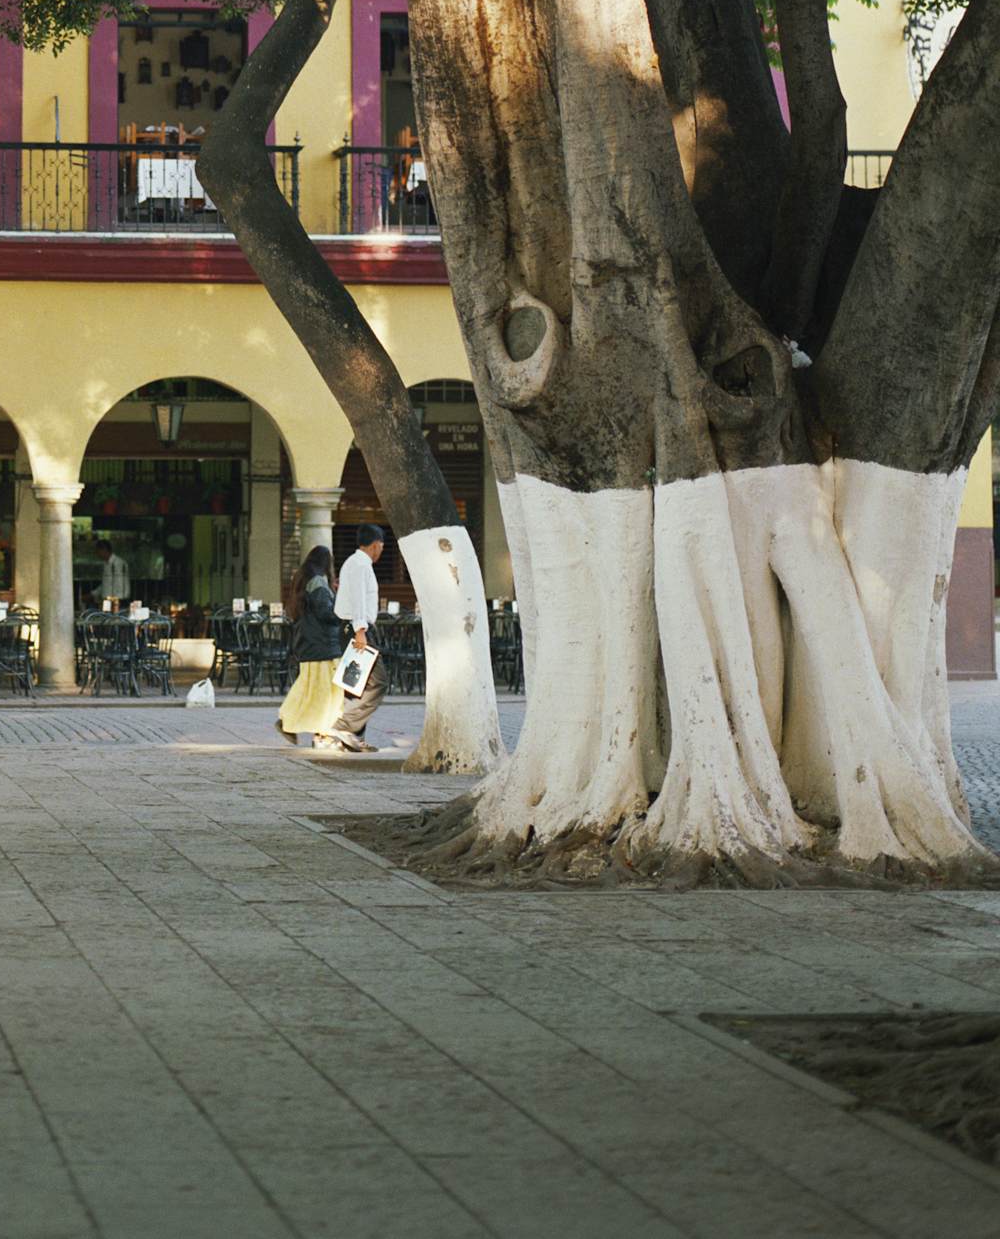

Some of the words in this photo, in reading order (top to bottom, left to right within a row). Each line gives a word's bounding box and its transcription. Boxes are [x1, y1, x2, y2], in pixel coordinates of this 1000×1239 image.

[438, 424, 479, 433] REVELADO
[438, 442, 454, 451] UNA
[456, 442, 479, 451] HORA
